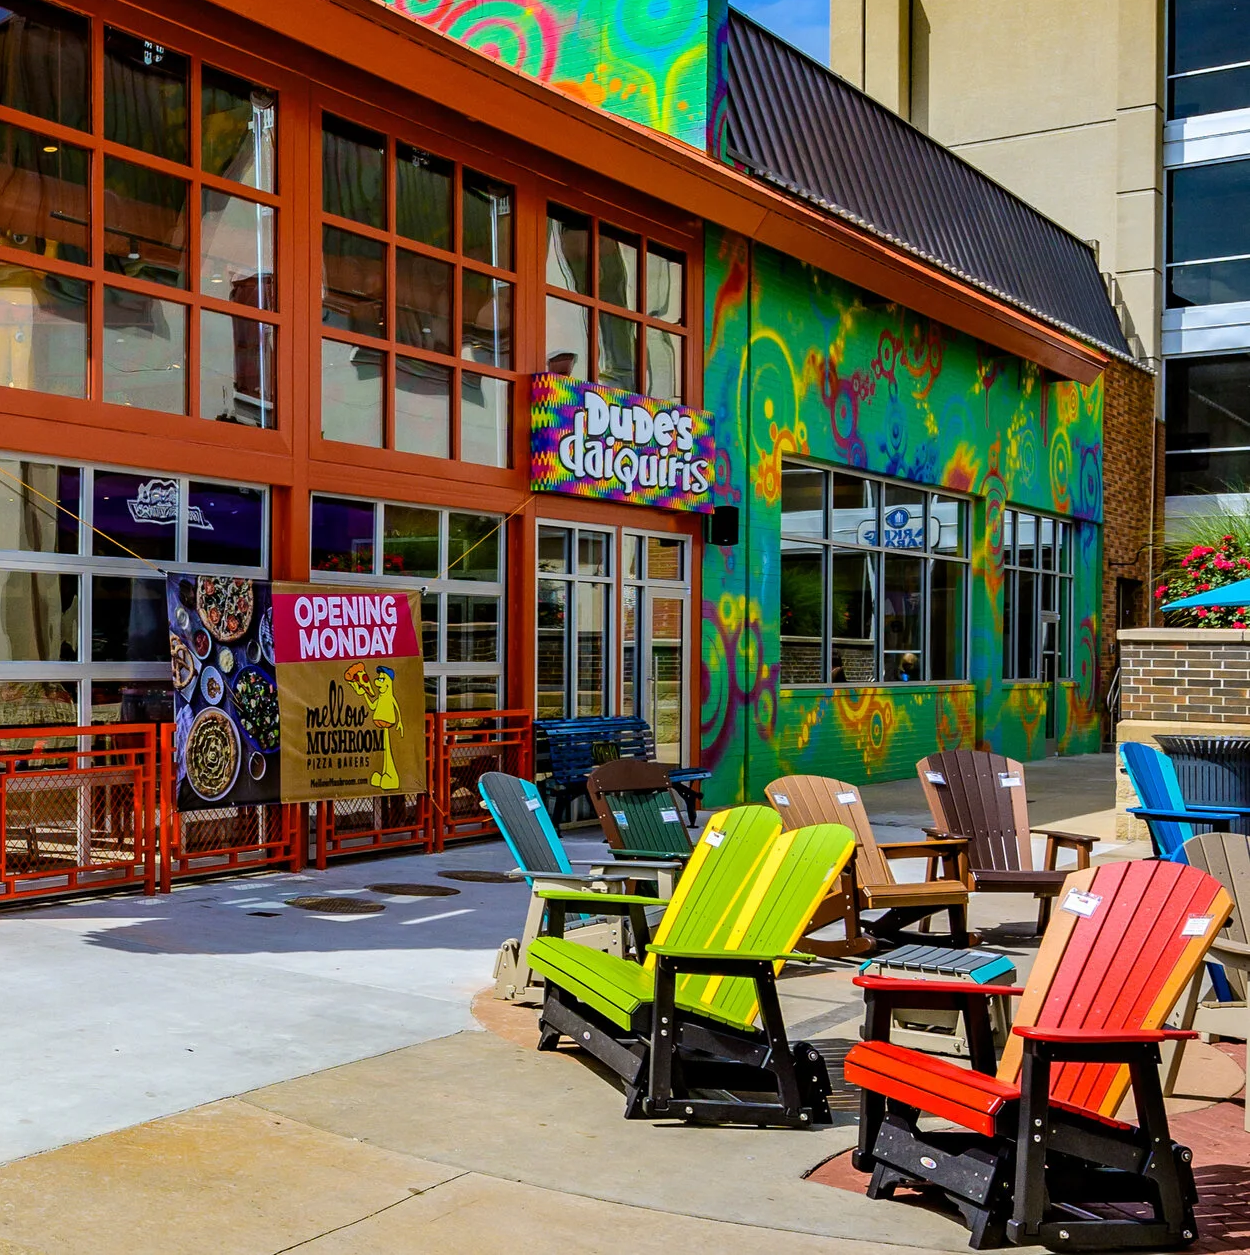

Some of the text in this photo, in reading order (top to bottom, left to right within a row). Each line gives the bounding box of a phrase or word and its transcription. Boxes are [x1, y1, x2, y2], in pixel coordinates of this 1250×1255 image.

[294, 595, 398, 627] OPENING
[299, 626, 397, 659] MONDAY
[306, 679, 369, 729] mellow
[306, 729, 386, 755] MUSHROOM
[307, 756, 370, 770] PIZZA BAKERS
